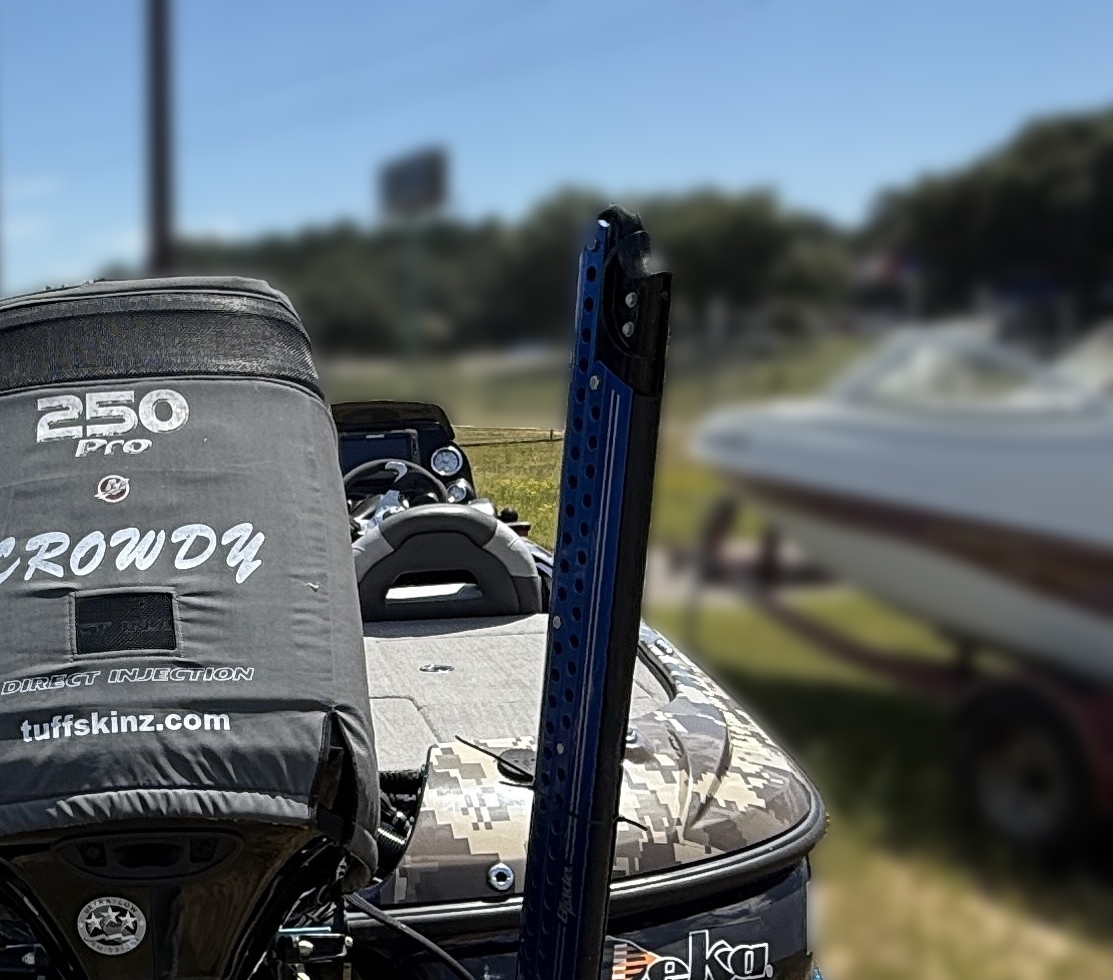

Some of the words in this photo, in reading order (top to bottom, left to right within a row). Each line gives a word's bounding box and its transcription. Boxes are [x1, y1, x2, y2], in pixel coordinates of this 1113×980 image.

[36, 388, 189, 443] 250
[1, 671, 101, 695] DIRECT
[108, 667, 255, 684] INJECTION
[21, 711, 231, 742] tuffskinz.com
